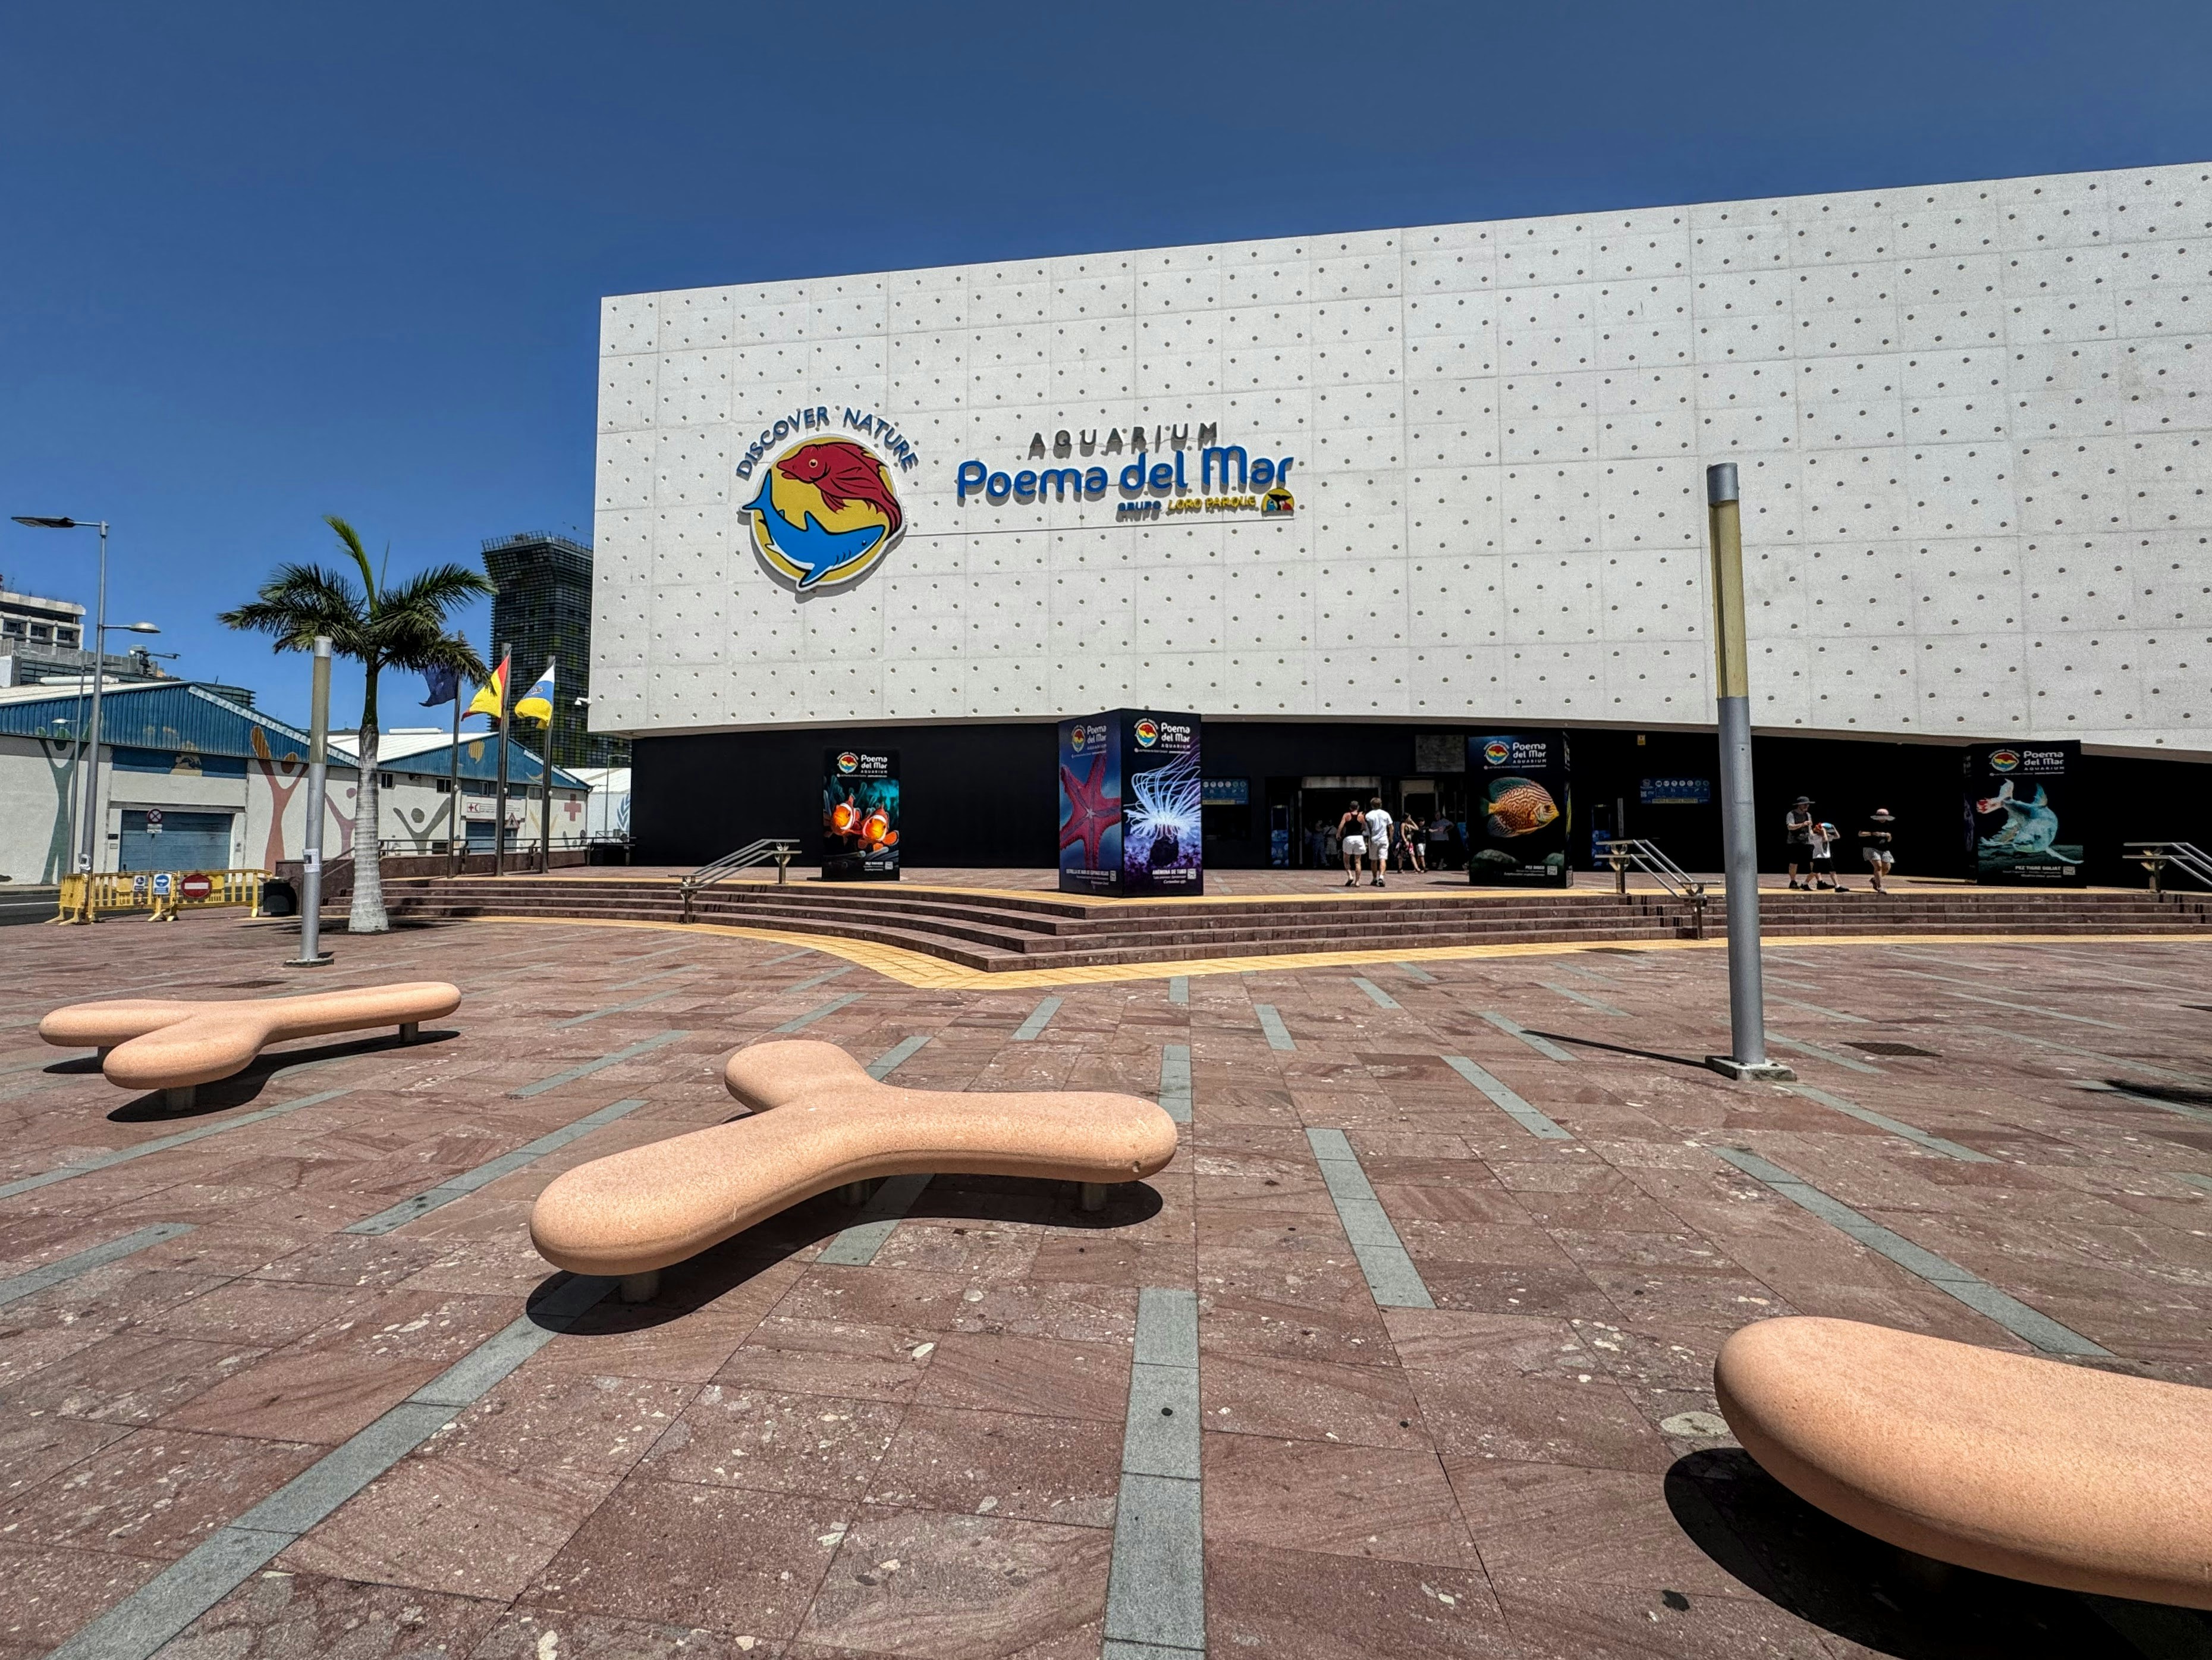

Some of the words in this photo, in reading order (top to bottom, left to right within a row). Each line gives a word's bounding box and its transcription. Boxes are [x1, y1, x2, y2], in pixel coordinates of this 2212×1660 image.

[736, 406, 830, 480] DISCOVER
[843, 407, 919, 473] NATURE
[1029, 422, 1217, 453] AQUARIUM
[957, 460, 1108, 500] Poema
[1120, 450, 1189, 491] del
[1202, 446, 1294, 487] Mar
[1168, 498, 1202, 510] LORO
[1205, 496, 1256, 507] PARQUE
[1088, 726, 1106, 735] Poema
[1161, 722, 1190, 733] Poema
[1161, 733, 1173, 742] del
[1175, 733, 1190, 742] Mar
[1513, 742, 1546, 751] Poema
